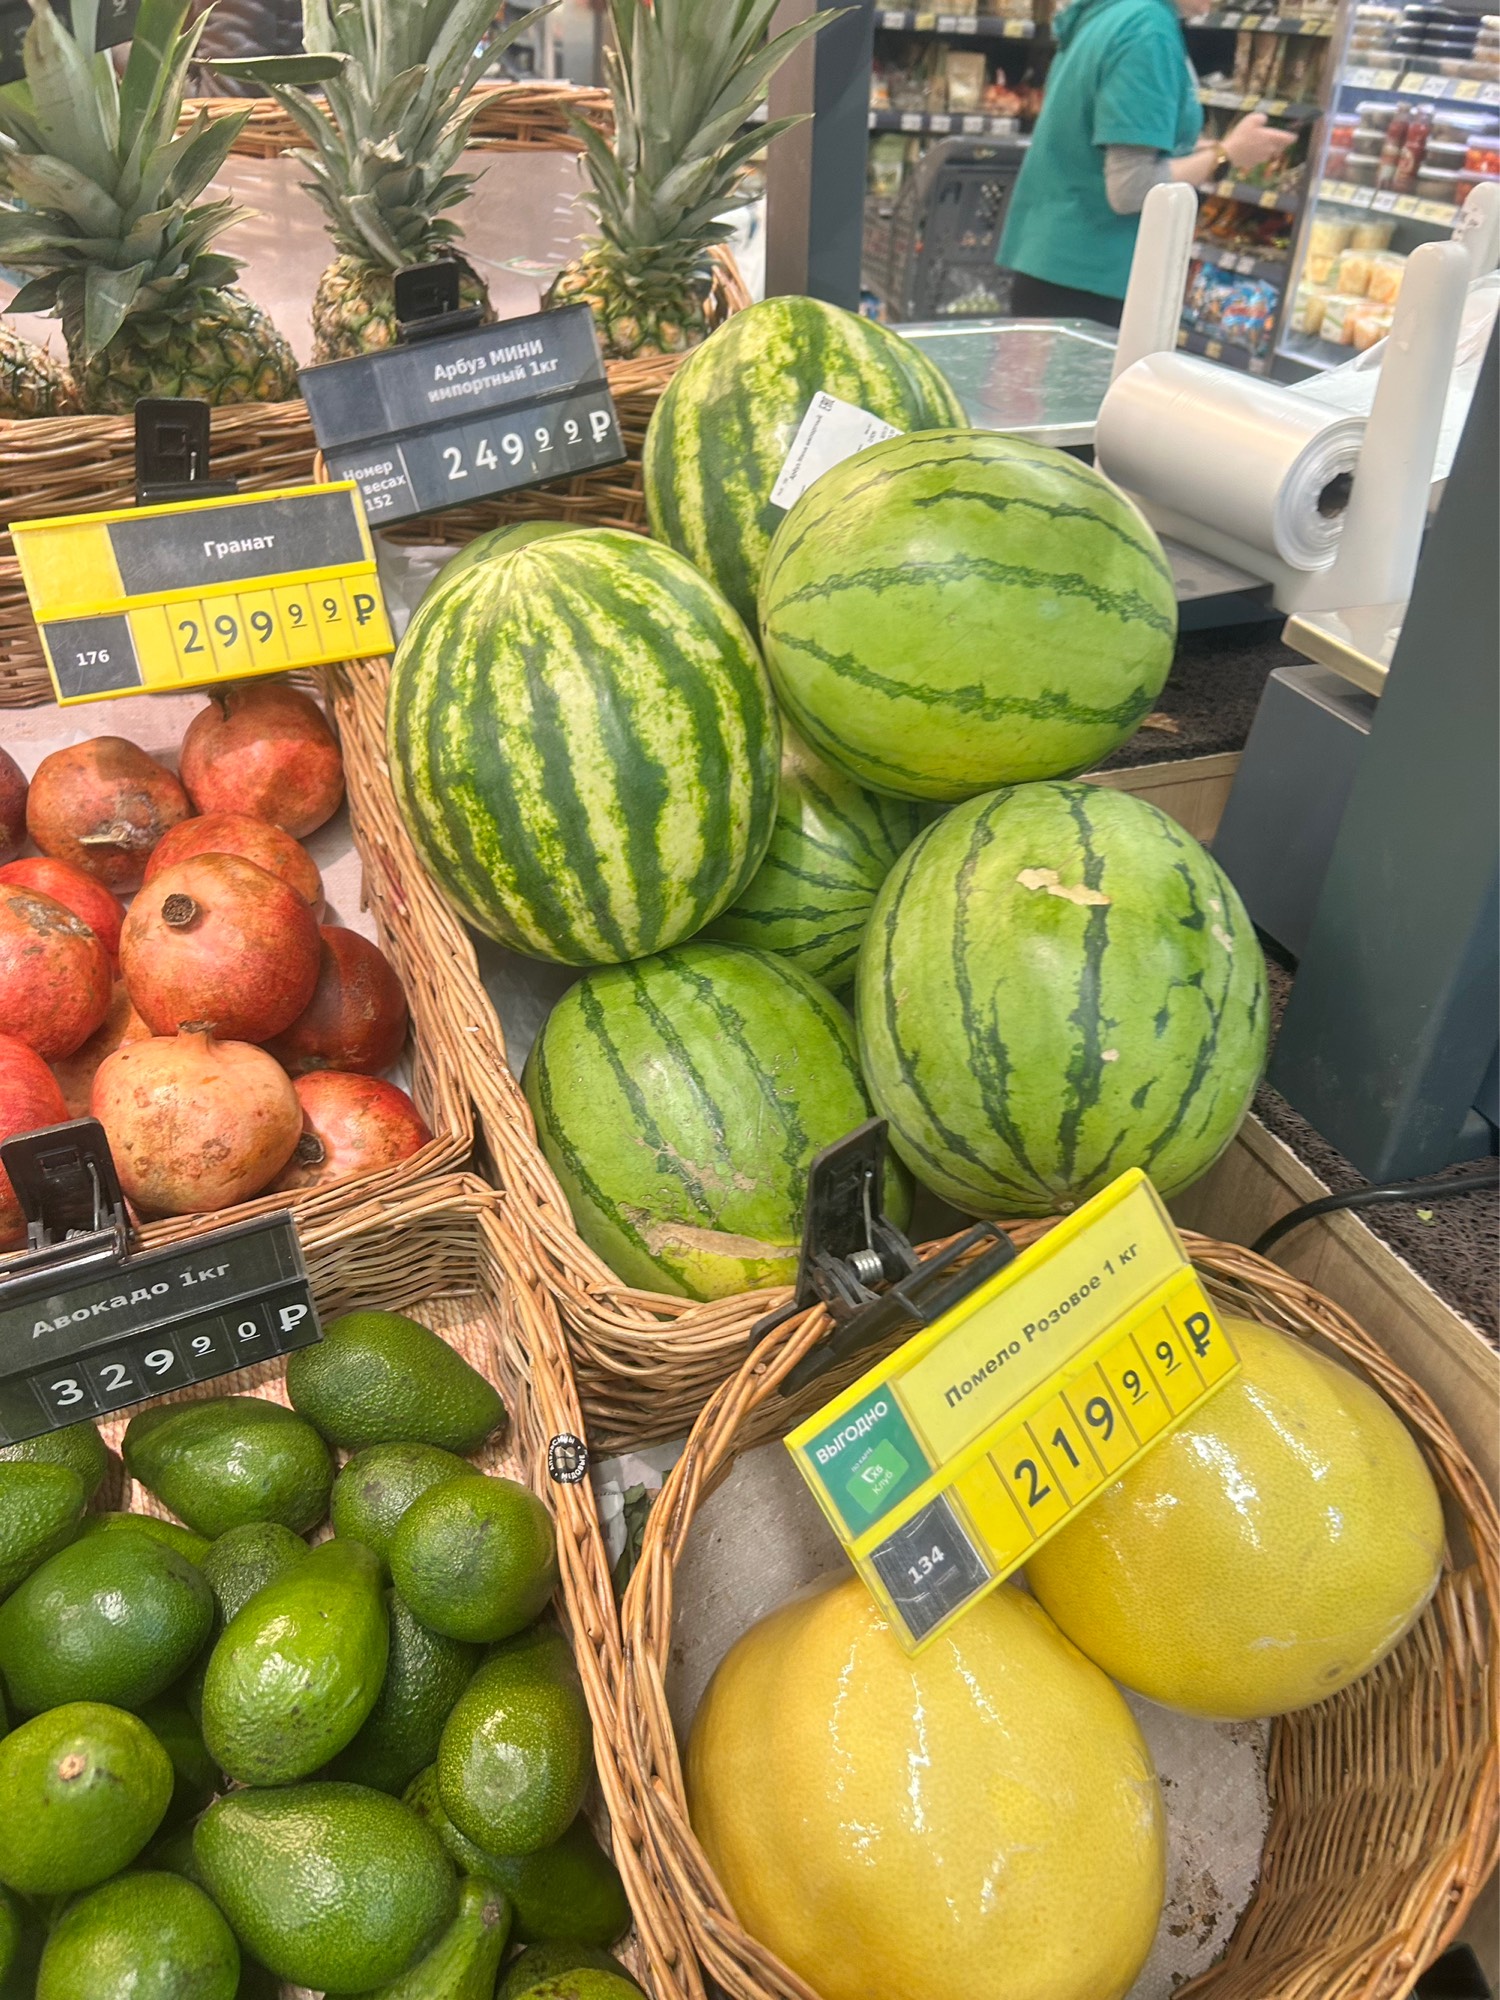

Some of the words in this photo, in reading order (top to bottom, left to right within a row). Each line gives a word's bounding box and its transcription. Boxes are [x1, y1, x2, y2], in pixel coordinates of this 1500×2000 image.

[434, 357, 487, 382] Арбуз
[490, 339, 544, 364] МИНИ
[428, 367, 527, 403] импортный
[531, 358, 559, 377] 1кг
[342, 460, 393, 481] Номер
[364, 473, 406, 494] весах
[364, 494, 393, 512] 152
[203, 535, 275, 559] Гранат
[76, 649, 110, 667] 176
[32, 1281, 170, 1340] Авокадо
[179, 1263, 230, 1288] 1кг
[944, 1338, 1022, 1409] Помело
[1022, 1277, 1104, 1344] Розовое
[1118, 1242, 1139, 1267] кг
[816, 1401, 888, 1464] ВЫГОДНО
[872, 1470, 894, 1495] Клуб
[907, 1544, 946, 1585] 134
